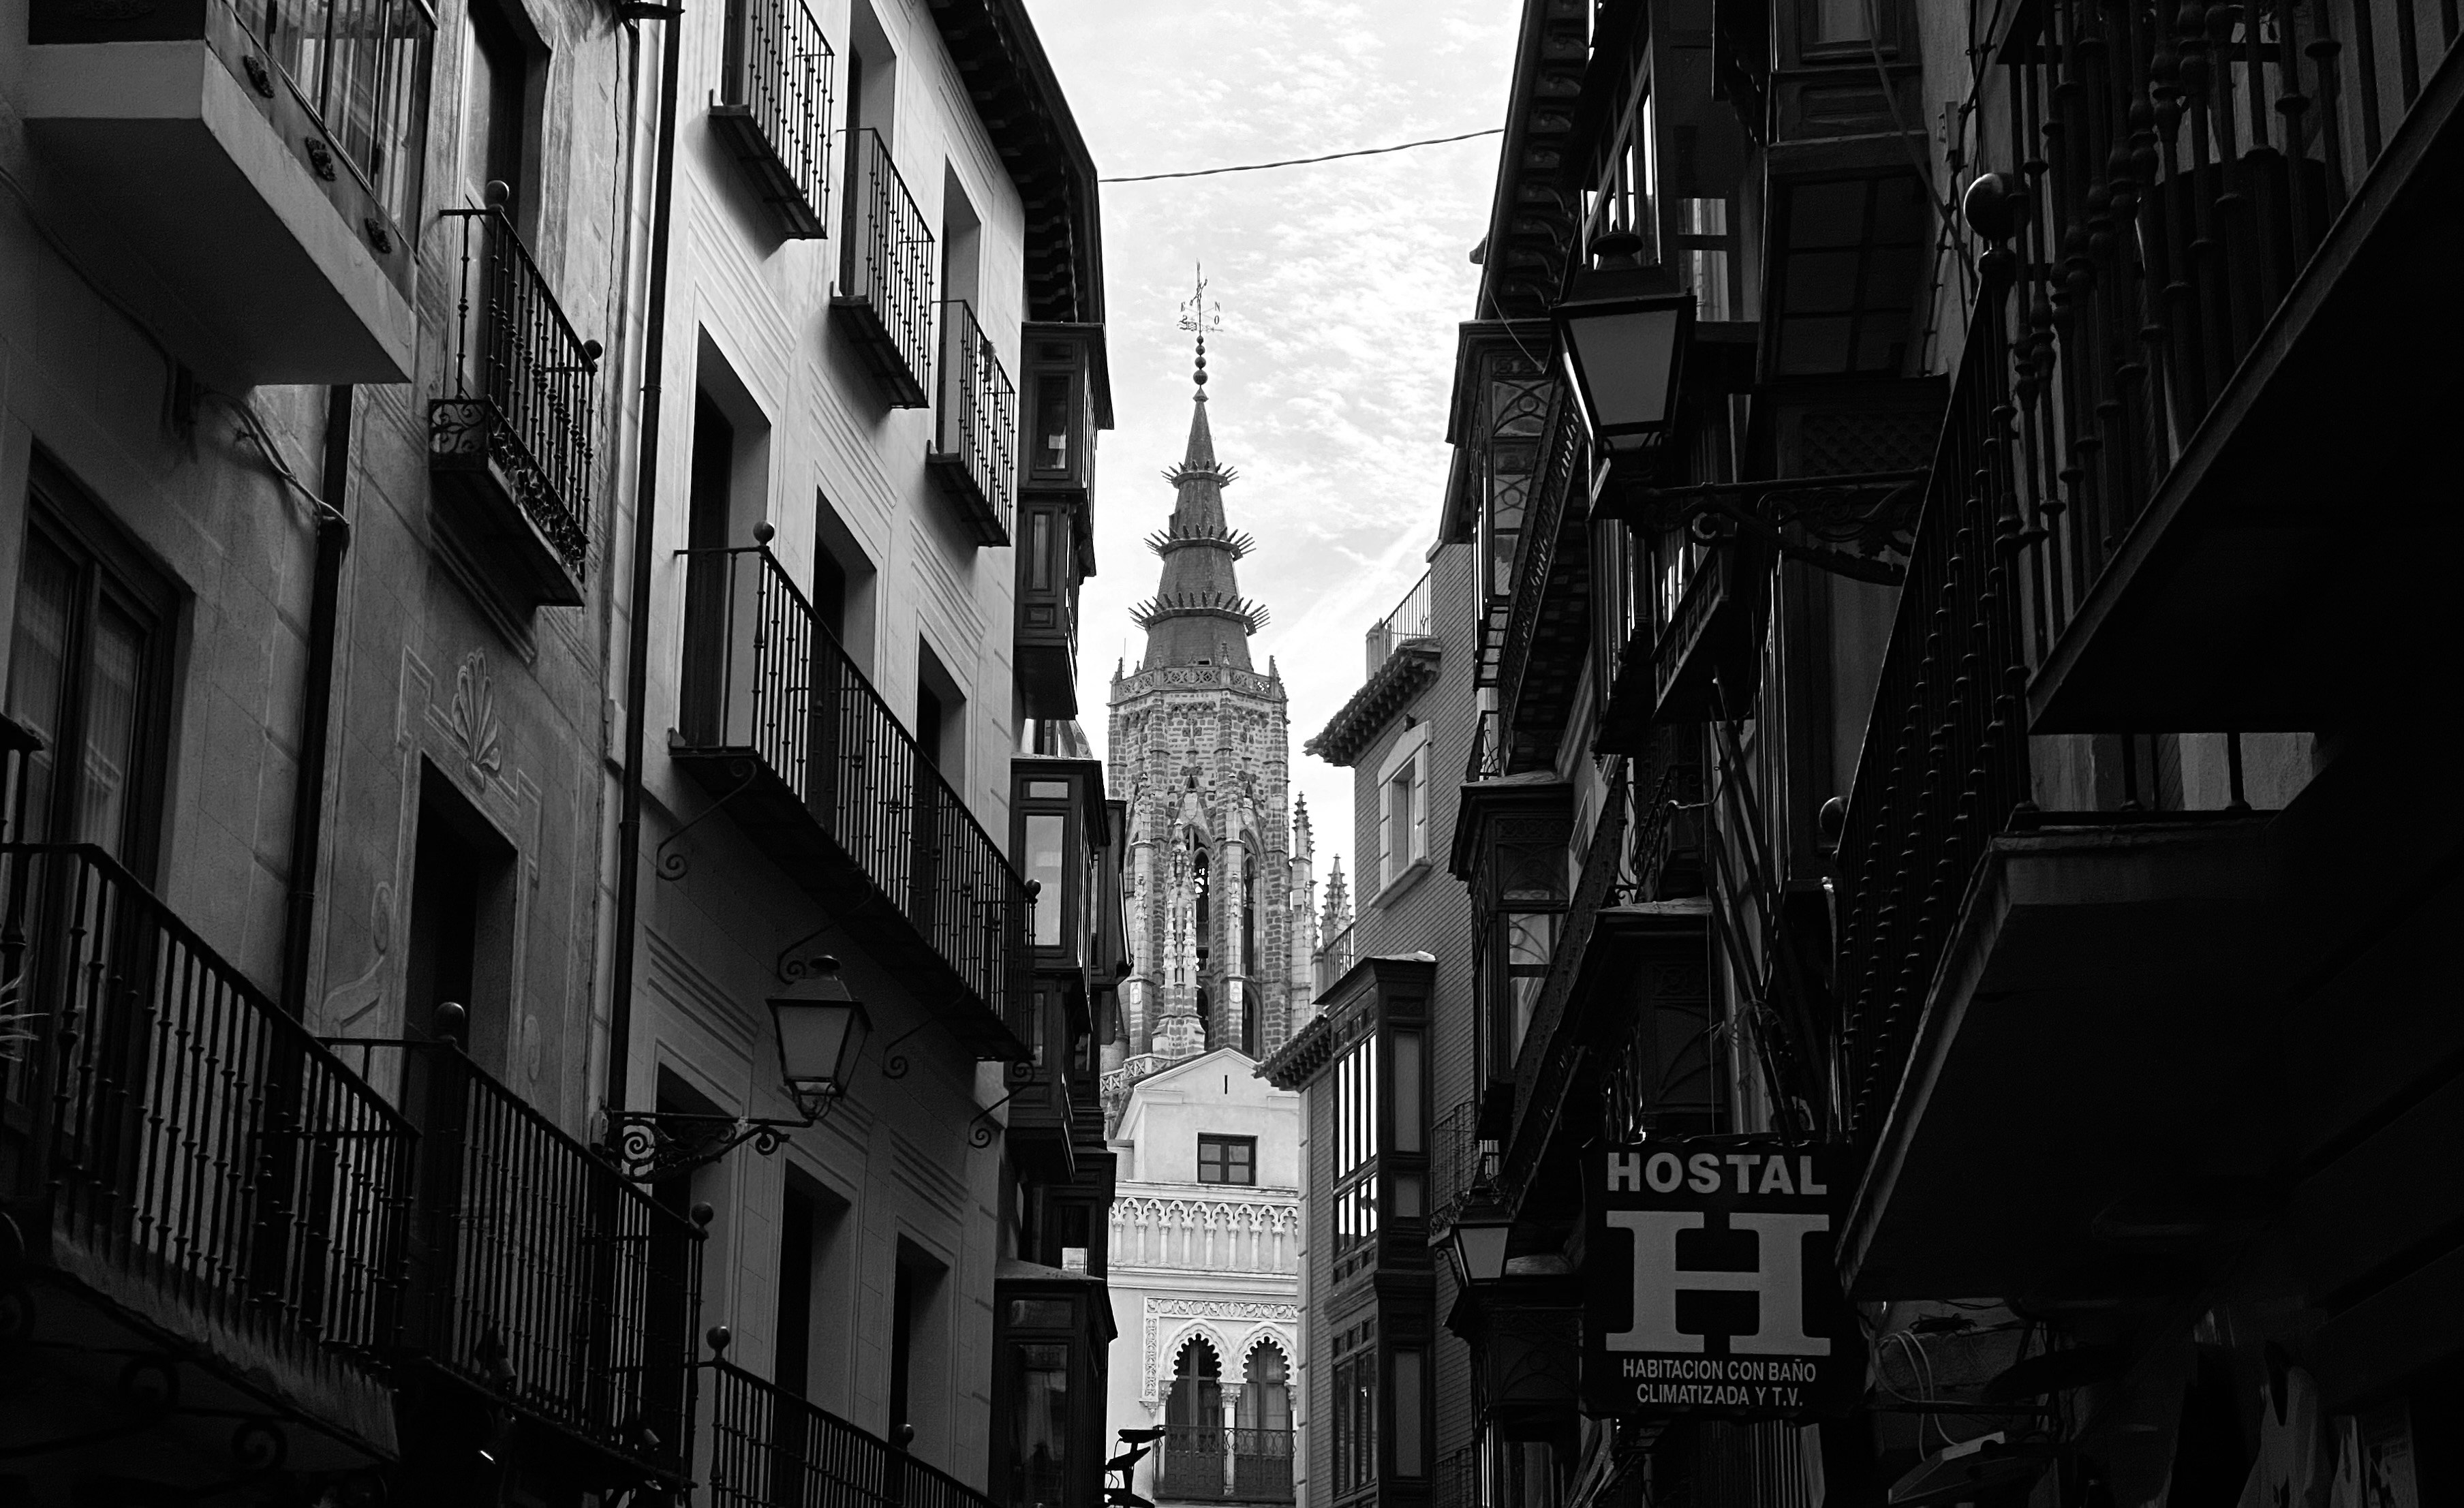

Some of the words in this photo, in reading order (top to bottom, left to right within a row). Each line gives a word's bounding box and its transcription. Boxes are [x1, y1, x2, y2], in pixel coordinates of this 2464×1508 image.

[1607, 1152, 1828, 1195] HOSTAL
[1605, 1210, 1831, 1356] H
[1623, 1358, 1723, 1380] HABITACION
[1727, 1361, 1764, 1381] CON
[1768, 1358, 1816, 1383] BAÑO
[1636, 1383, 1750, 1405] CLIMATIZADA
[1755, 1386, 1767, 1406] Y
[1772, 1387, 1803, 1406] T.V.
